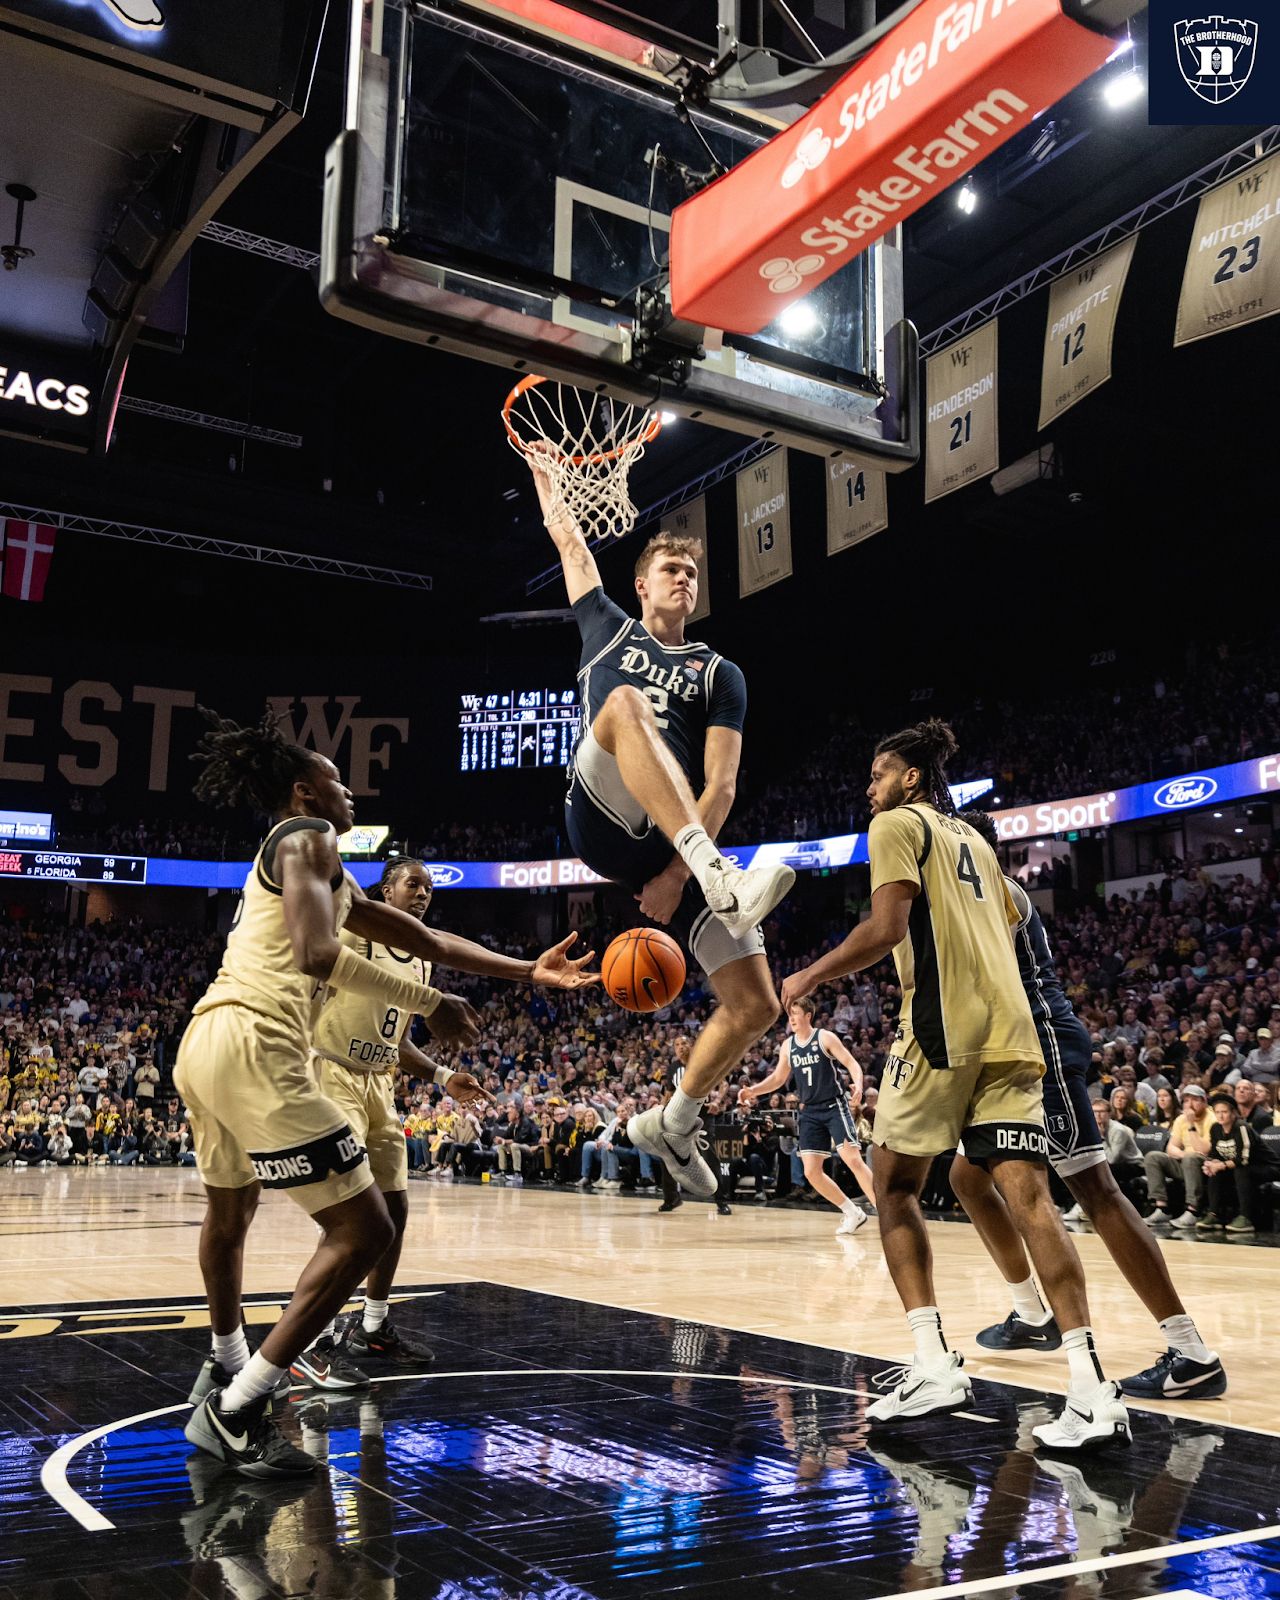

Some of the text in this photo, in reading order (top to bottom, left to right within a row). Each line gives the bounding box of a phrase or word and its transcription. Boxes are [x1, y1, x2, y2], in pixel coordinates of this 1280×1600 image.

[1213, 235, 1261, 285] 23
[1050, 284, 1112, 341] PRIVETTE
[1206, 297, 1263, 324] 1988-1991
[950, 347, 973, 367] WF
[1062, 322, 1086, 368] 12
[928, 371, 994, 423] HENDERSON
[949, 409, 972, 453] 21
[754, 465, 770, 484] WF
[846, 470, 866, 509] 14
[743, 491, 786, 528] J. JACKSON
[757, 521, 774, 555] 13
[617, 645, 700, 702] Duke
[461, 695, 483, 711] WF
[485, 695, 498, 708] 47
[518, 691, 541, 707] 4:31
[561, 690, 574, 704] 49
[501, 711, 508, 721] 3
[1258, 758, 1280, 790] F
[1165, 780, 1205, 804] Ford
[994, 796, 1111, 837] co Sport
[0, 853, 22, 862] SEAT
[0, 862, 21, 873] GEEK
[35, 854, 81, 867] GEORGIA
[34, 867, 76, 878] FLORIDA
[103, 871, 114, 880] 89
[500, 861, 602, 886] Ford Bro
[956, 842, 984, 902] 4
[381, 1008, 399, 1039] 8
[791, 1052, 820, 1068] Duke
[885, 1055, 913, 1089] WF
[801, 1066, 812, 1087] 7
[336, 1134, 361, 1163] DE
